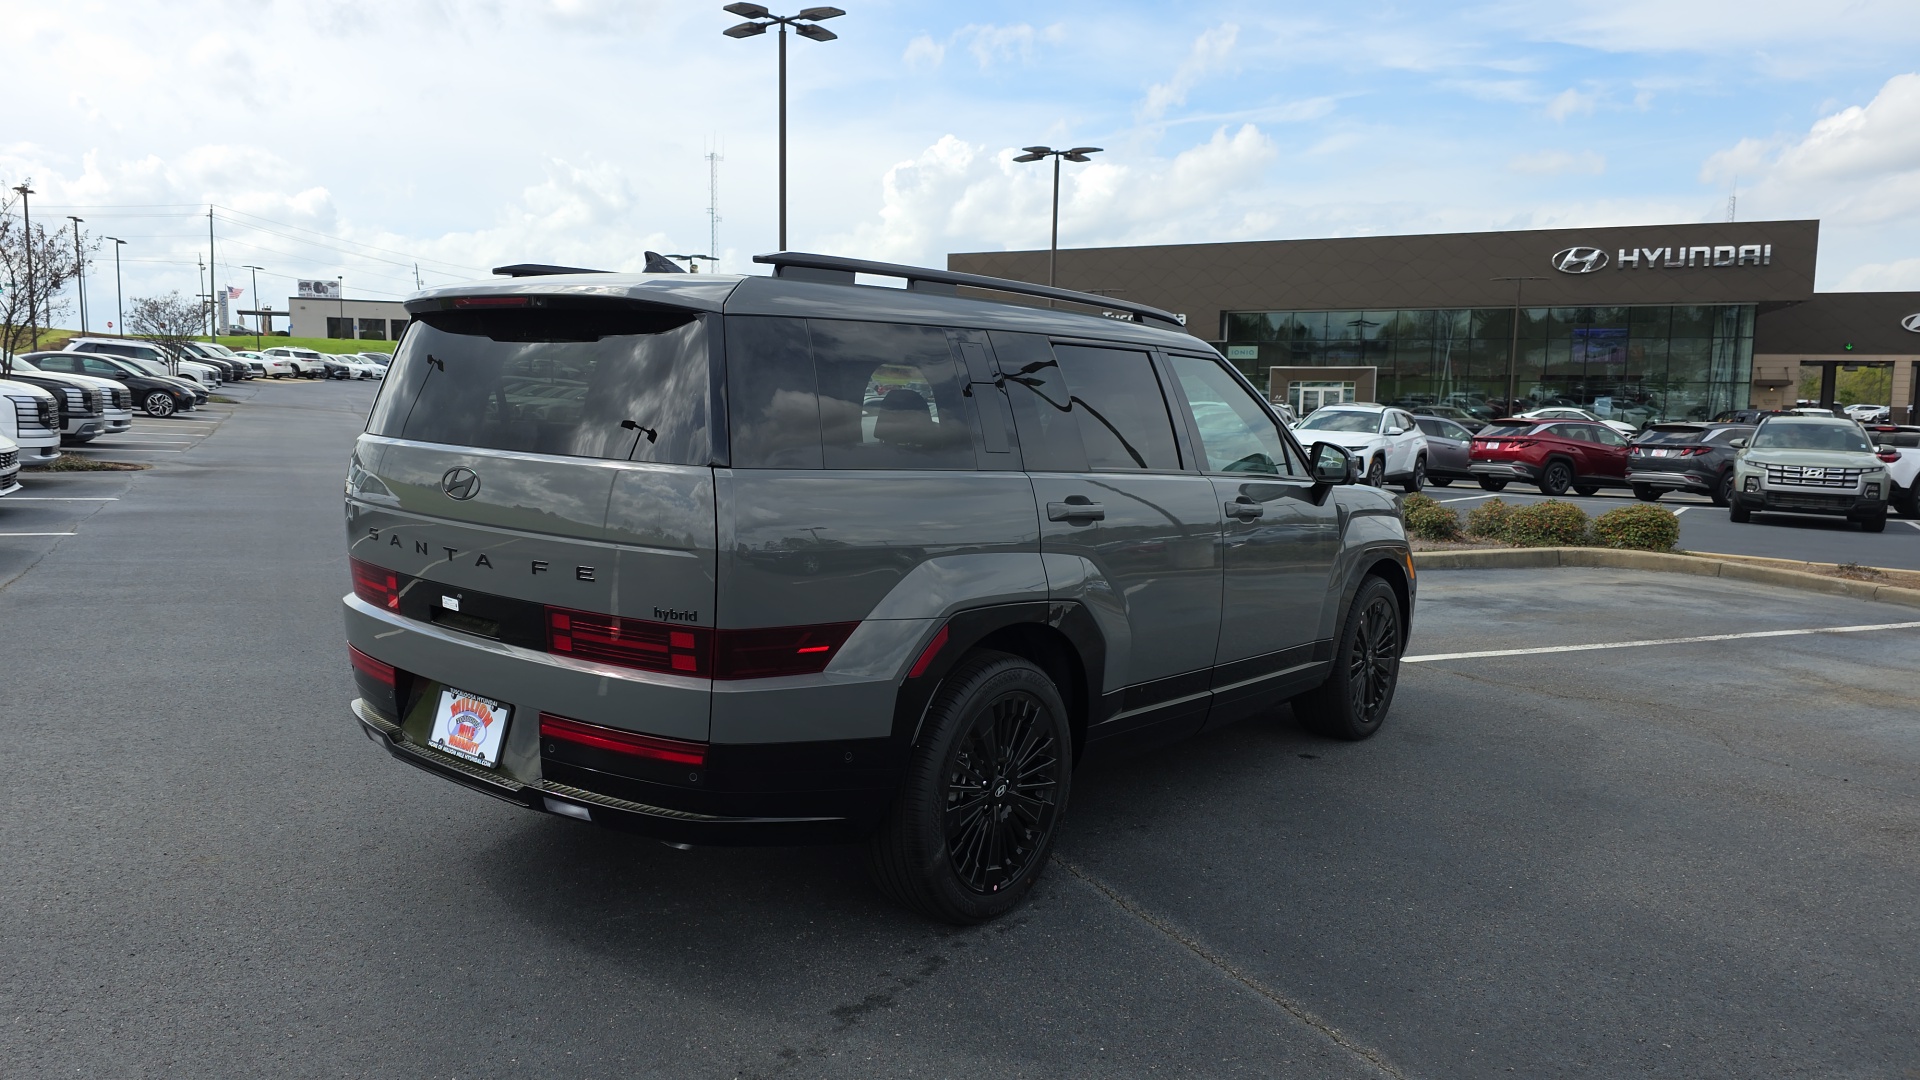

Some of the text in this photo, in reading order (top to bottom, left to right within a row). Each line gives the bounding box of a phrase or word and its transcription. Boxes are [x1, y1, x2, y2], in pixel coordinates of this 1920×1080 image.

[1617, 244, 1772, 269] HYUNDAI
[368, 526, 596, 583] SANTA FE
[653, 605, 698, 622] hybrid
[450, 697, 494, 729] MILLION
[458, 723, 476, 741] MILE
[448, 734, 480, 755] WARRANTY
